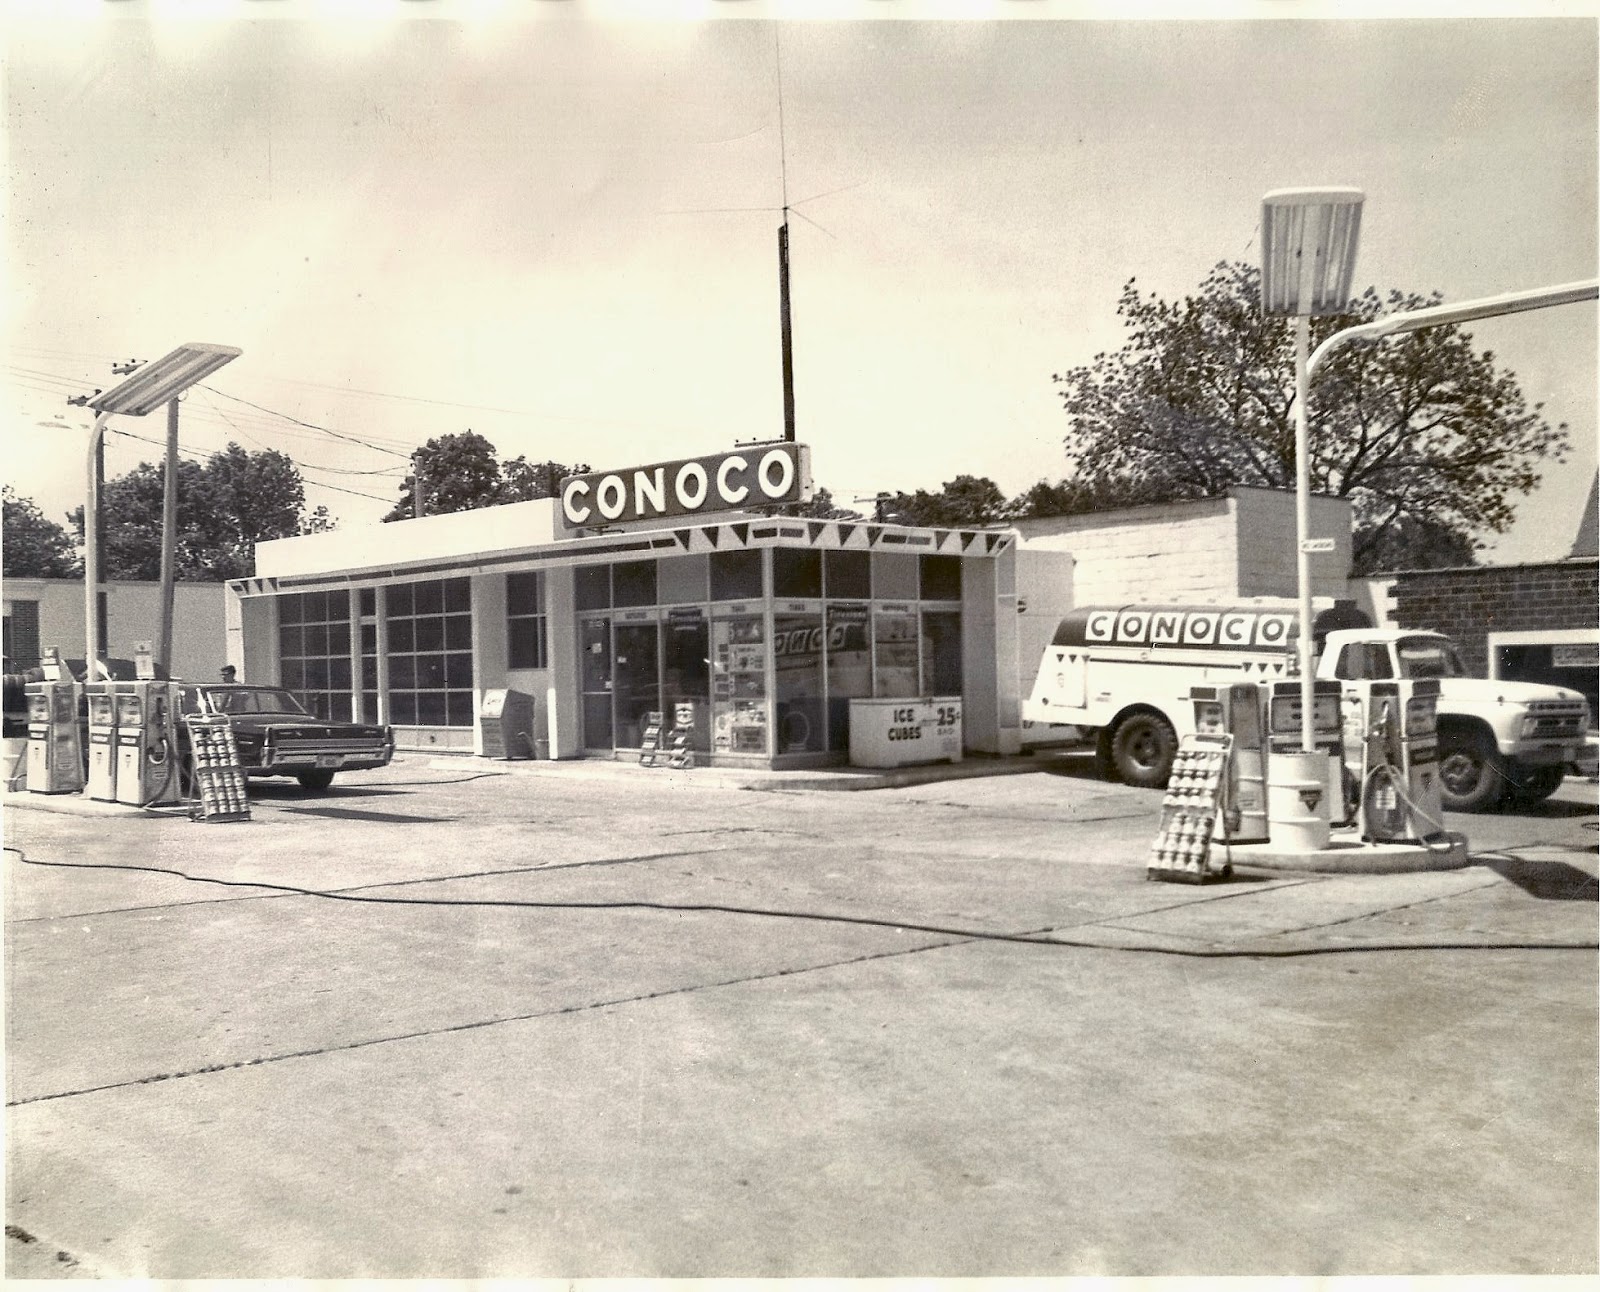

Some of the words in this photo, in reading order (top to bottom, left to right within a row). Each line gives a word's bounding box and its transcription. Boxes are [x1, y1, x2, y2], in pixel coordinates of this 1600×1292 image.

[563, 449, 794, 524] CONOCO
[1091, 615, 1285, 642] CONOCO
[893, 708, 914, 723] ICE
[888, 726, 921, 741] CUBES
